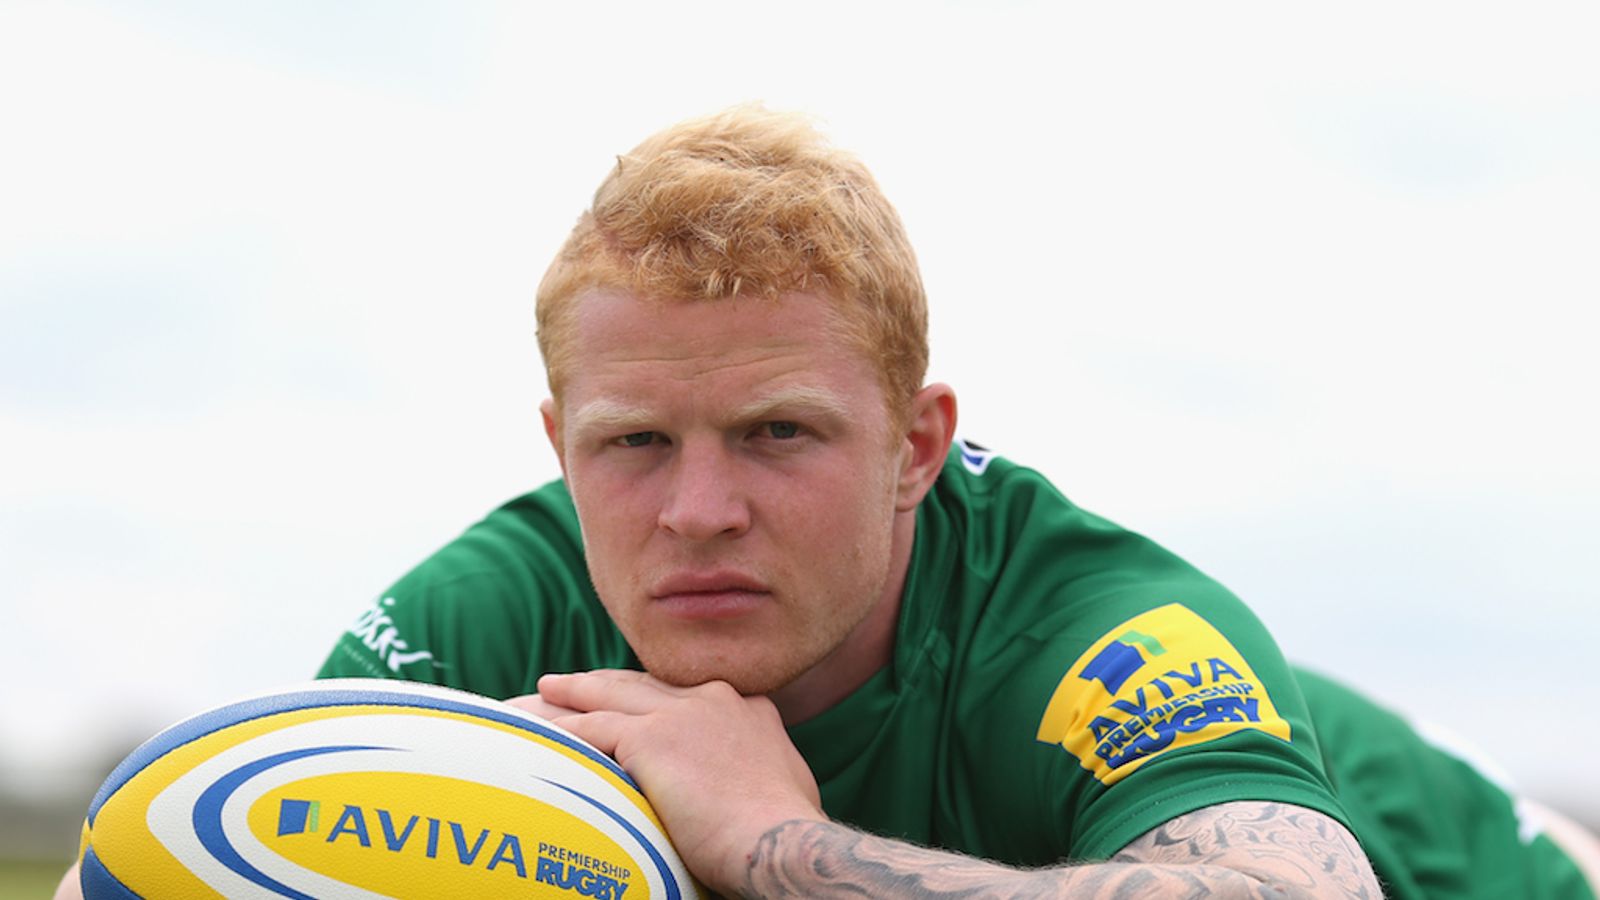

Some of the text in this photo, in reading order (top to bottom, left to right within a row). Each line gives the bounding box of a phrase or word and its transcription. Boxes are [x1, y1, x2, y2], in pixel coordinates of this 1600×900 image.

[1088, 657, 1244, 743] AVIVA
[1094, 682, 1254, 761] PREMIERSHIP
[1105, 698, 1261, 769] RUGBY
[326, 804, 527, 878] AVIVA
[538, 842, 631, 880] PREMIERSHIP
[535, 856, 629, 900] RUGBY
